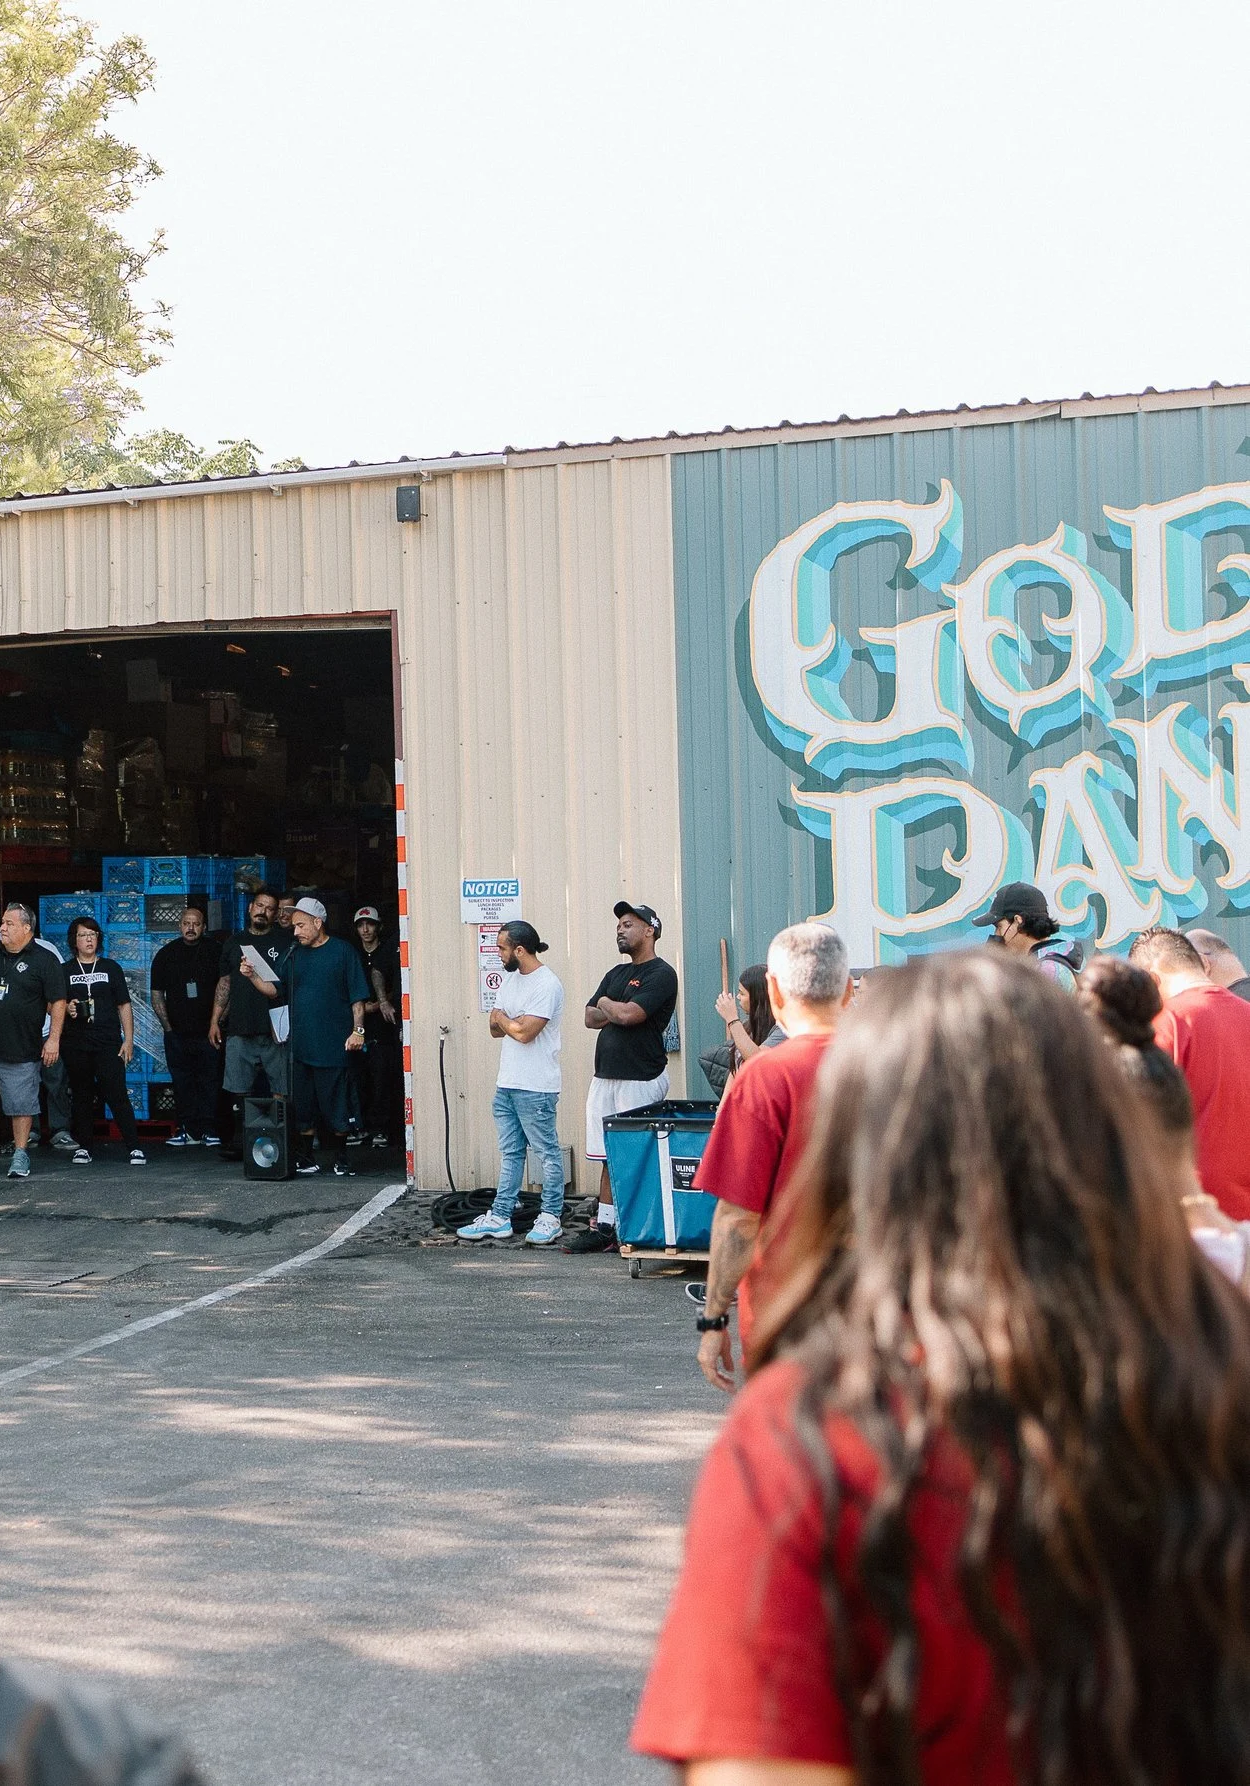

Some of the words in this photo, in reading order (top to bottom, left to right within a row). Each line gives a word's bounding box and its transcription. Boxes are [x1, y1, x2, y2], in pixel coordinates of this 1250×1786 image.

[790, 664, 1250, 966] PAN
[465, 882, 518, 896] NOTICE
[675, 1164, 696, 1173] ULINE
